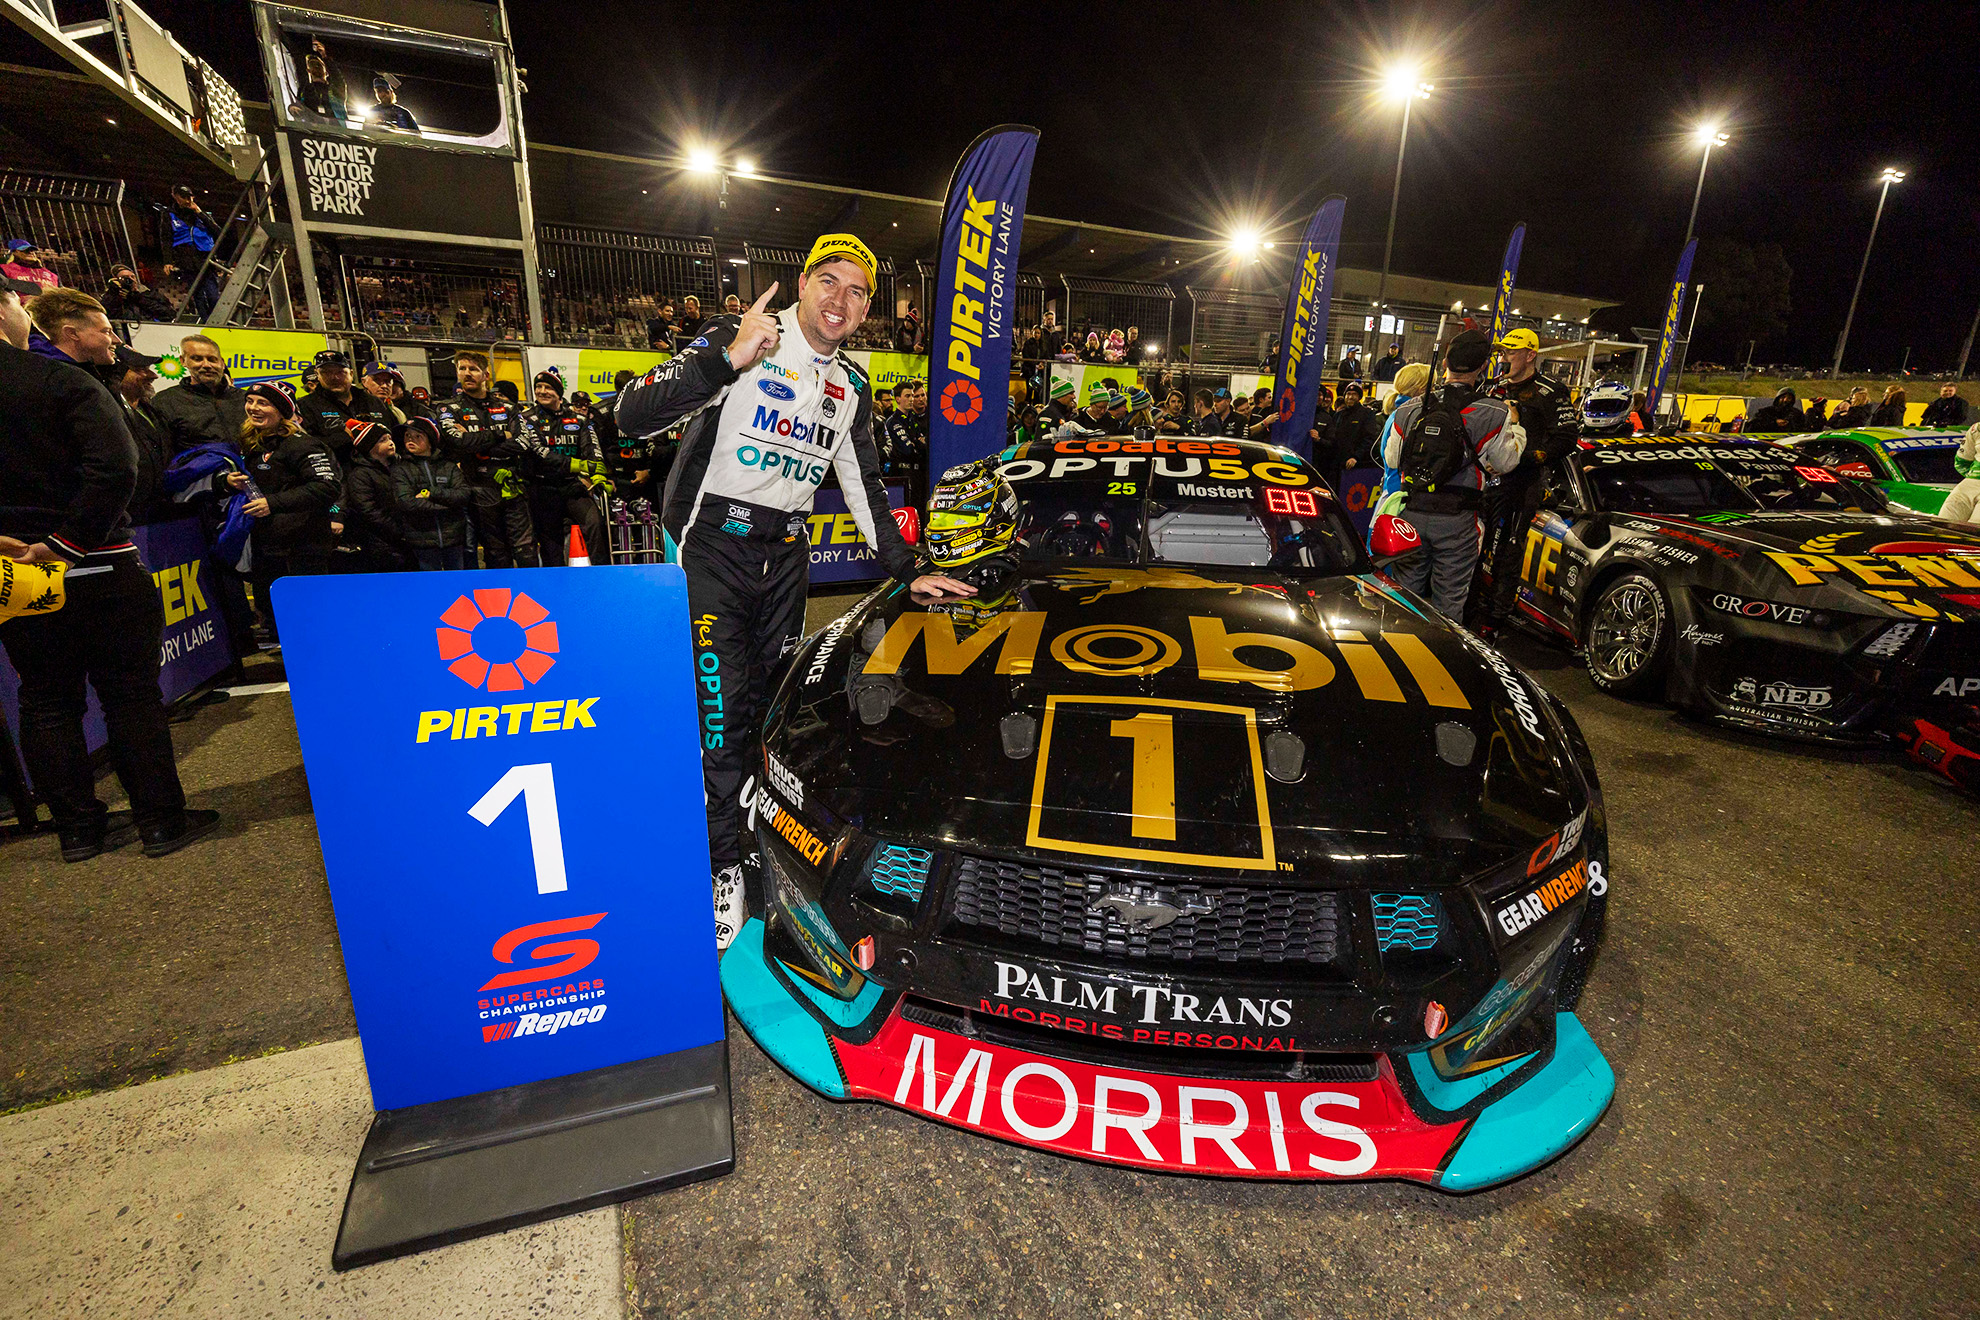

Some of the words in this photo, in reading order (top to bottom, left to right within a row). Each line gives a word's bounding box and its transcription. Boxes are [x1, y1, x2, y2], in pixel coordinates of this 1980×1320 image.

[301, 138, 377, 165] SYDNEY
[303, 157, 375, 183] MOTOR
[308, 175, 372, 199] SPORT
[310, 192, 364, 216] PARK
[996, 202, 1014, 255] LANE
[820, 240, 874, 268] DUNLOP
[947, 185, 997, 380] PIRTEK
[988, 258, 1006, 339] VICTORY
[1285, 241, 1322, 388] PIRTEK
[1304, 295, 1321, 357] VICTORY
[1316, 252, 1329, 292] LANE
[765, 382, 788, 399] Ford
[752, 404, 817, 444] Mobil
[736, 445, 825, 486] OPTUS
[1594, 446, 1771, 464] Steadfast
[1694, 461, 1714, 471] 19
[1738, 461, 1792, 472] Payne
[1107, 482, 1137, 495] 25
[1840, 469, 1873, 478] RYCO
[1177, 483, 1254, 500] Mostert
[728, 506, 751, 518] OMP
[1520, 528, 1563, 596] TE
[1659, 545, 1699, 565] FISHER
[1760, 551, 1980, 588] PEN
[0, 558, 14, 607] DUNLOP
[1712, 593, 1806, 625] GROVE
[184, 620, 214, 652] LANE
[694, 613, 719, 648] yes
[861, 611, 1472, 710] Mobil
[698, 651, 724, 750] OPTUS
[1763, 685, 1833, 706] NED
[415, 697, 601, 743] PIRTEK
[1729, 704, 1782, 720] AUSTRALIAN
[1786, 715, 1821, 728] WHISKY
[768, 752, 804, 797] TRUCK
[768, 771, 804, 811] ASSIST
[1109, 711, 1177, 841] 1
[467, 762, 568, 895] 1
[1278, 863, 1295, 873] TM
[477, 978, 605, 1010] SUPERCARS
[479, 989, 606, 1019] CHAMPIONSHIP
[993, 960, 1118, 1015] PALM
[1131, 985, 1294, 1028] TRANS
[513, 1003, 608, 1038] Repco
[980, 998, 1124, 1041] MORRIS
[1132, 1028, 1304, 1052] PERSONAL
[893, 1033, 1379, 1177] MORRIS
